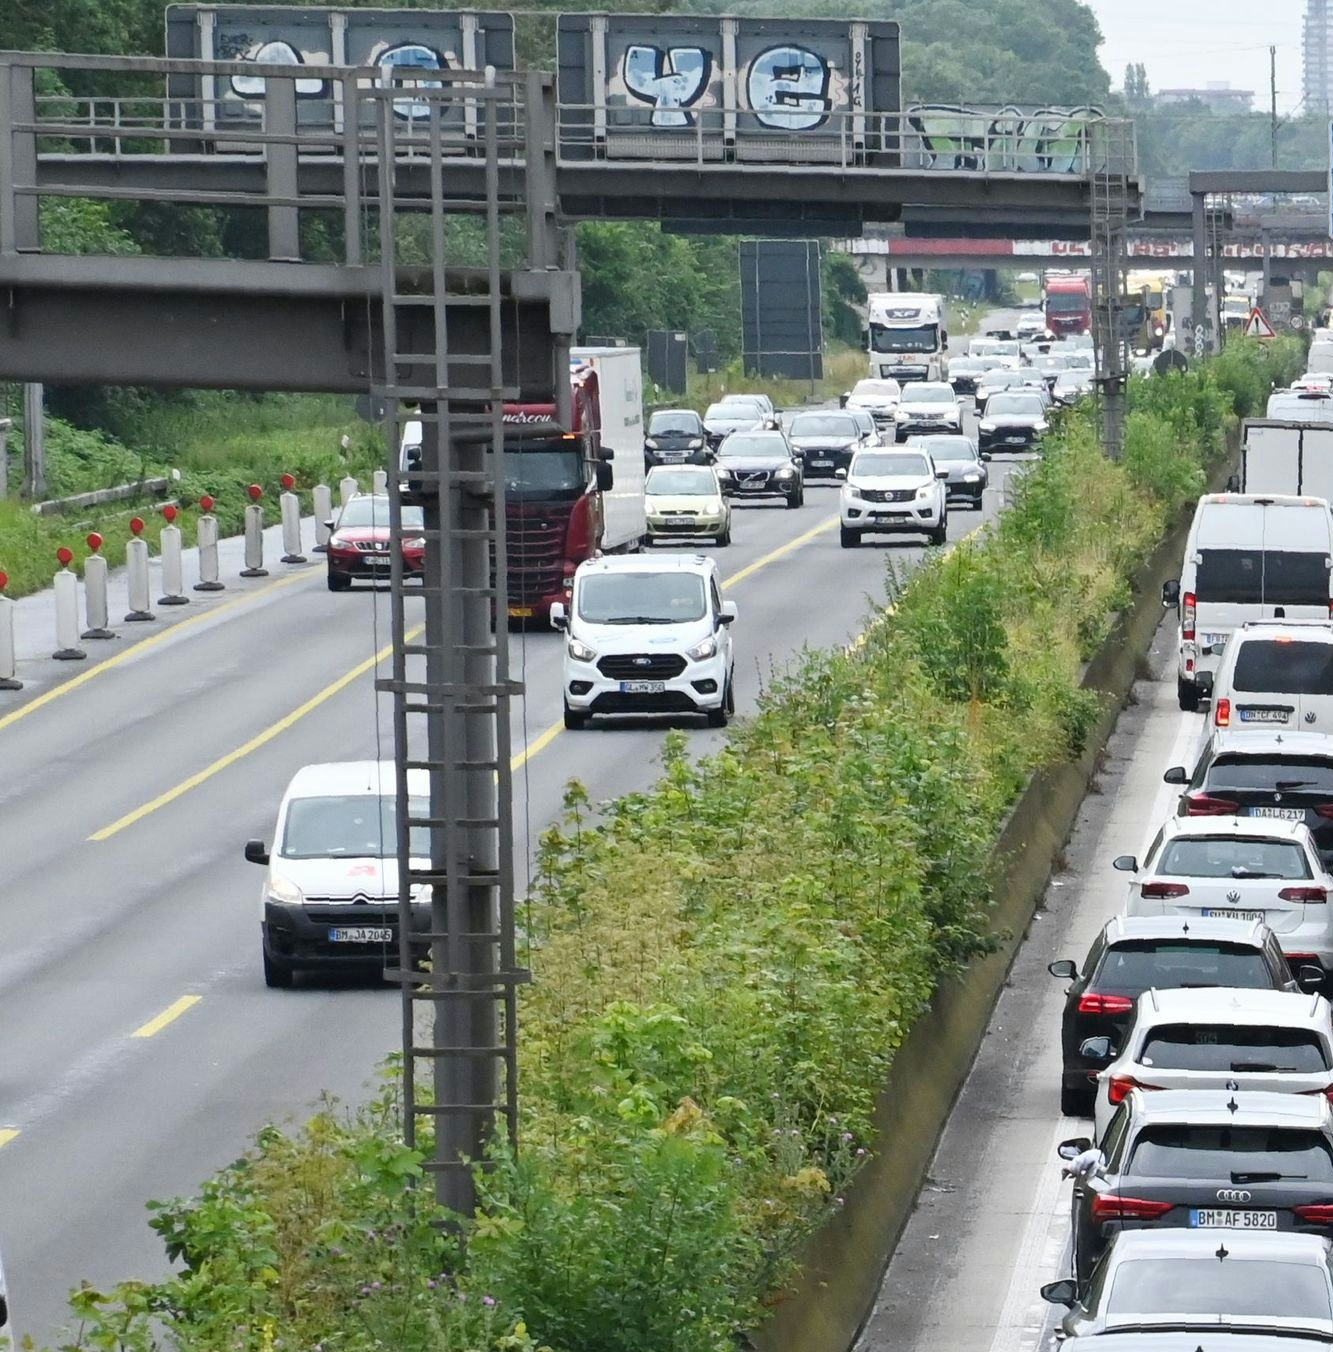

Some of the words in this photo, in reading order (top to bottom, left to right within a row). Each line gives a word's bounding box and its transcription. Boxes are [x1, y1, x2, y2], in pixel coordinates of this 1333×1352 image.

[1198, 1211, 1215, 1225] BM
[1225, 1212, 1241, 1226] AF
[1244, 1213, 1275, 1227] 5820
